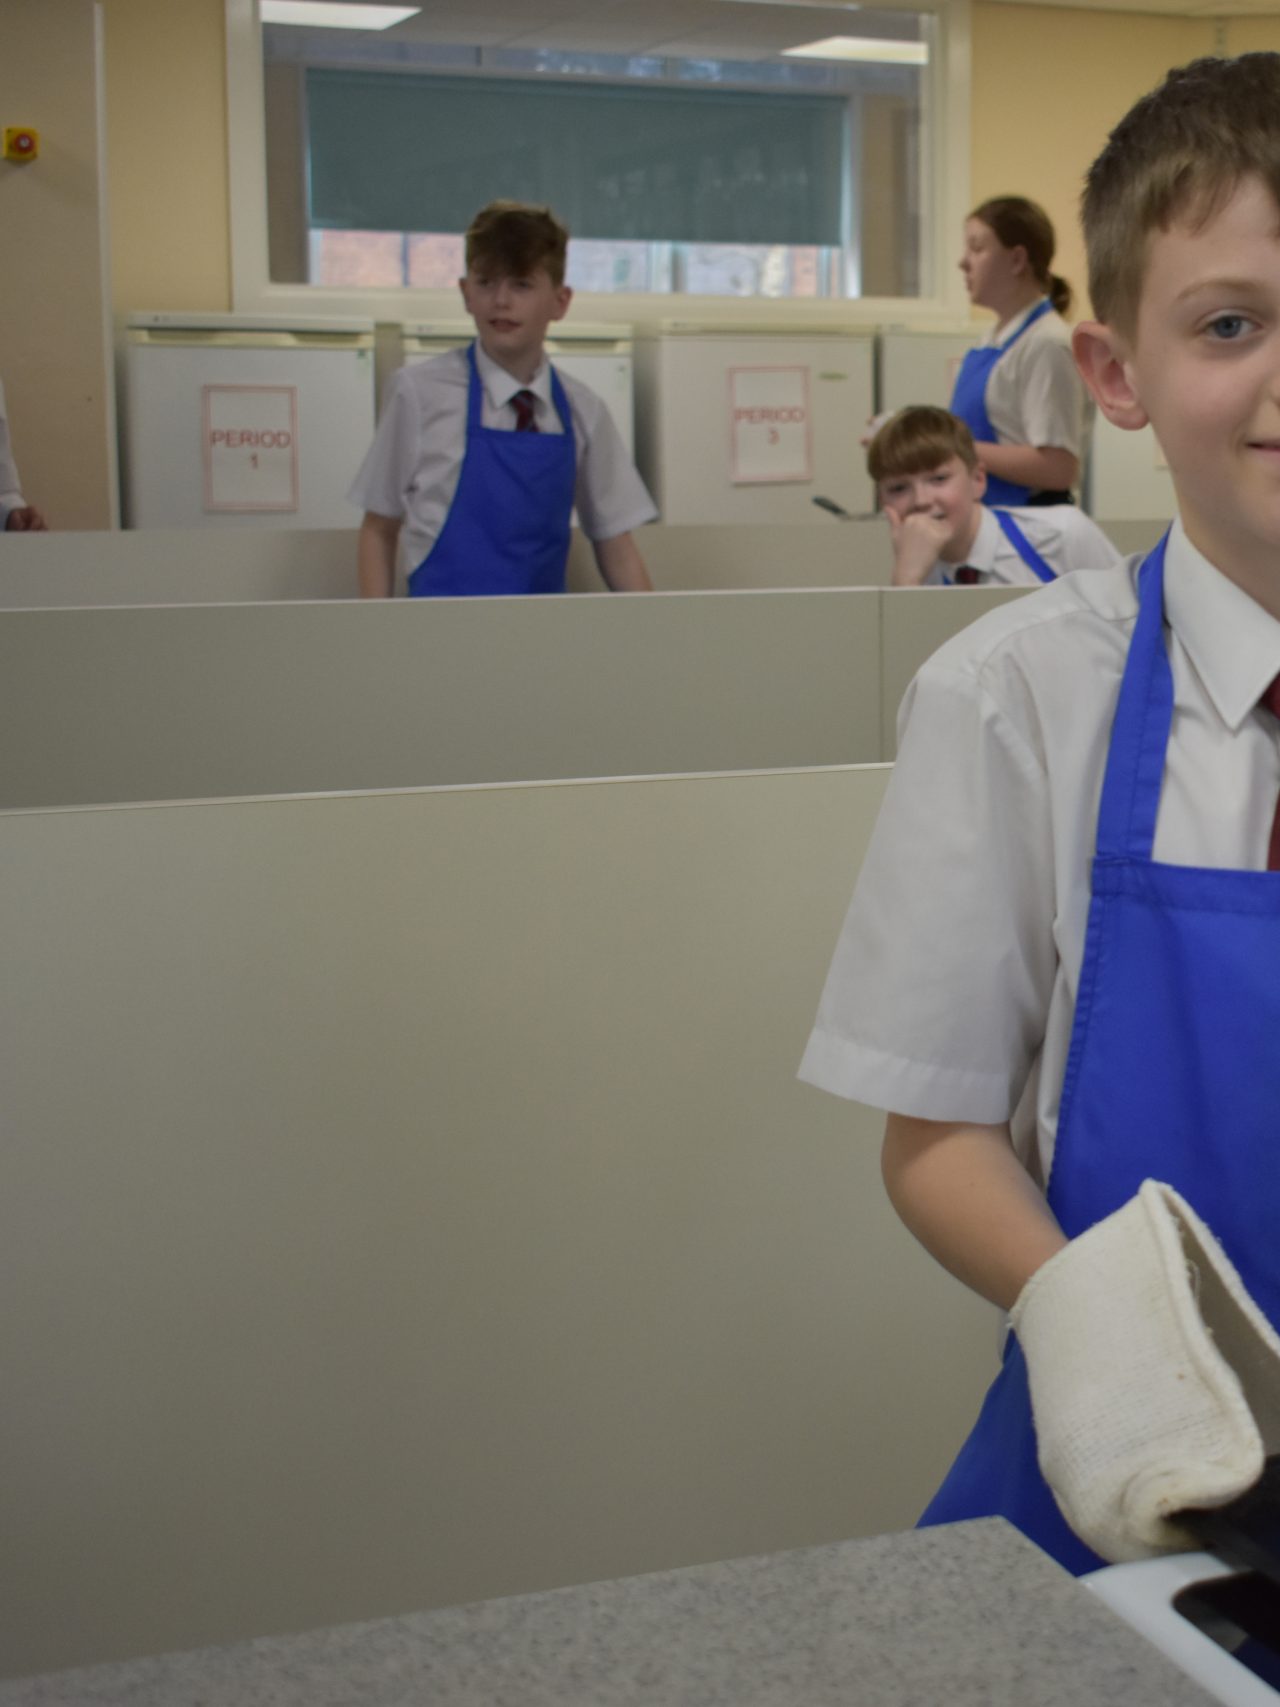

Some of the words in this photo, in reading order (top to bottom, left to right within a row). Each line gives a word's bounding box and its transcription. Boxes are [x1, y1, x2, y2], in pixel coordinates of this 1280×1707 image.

[734, 407, 805, 424] PERIOD
[210, 430, 291, 448] PERIOD
[250, 452, 258, 469] 1
